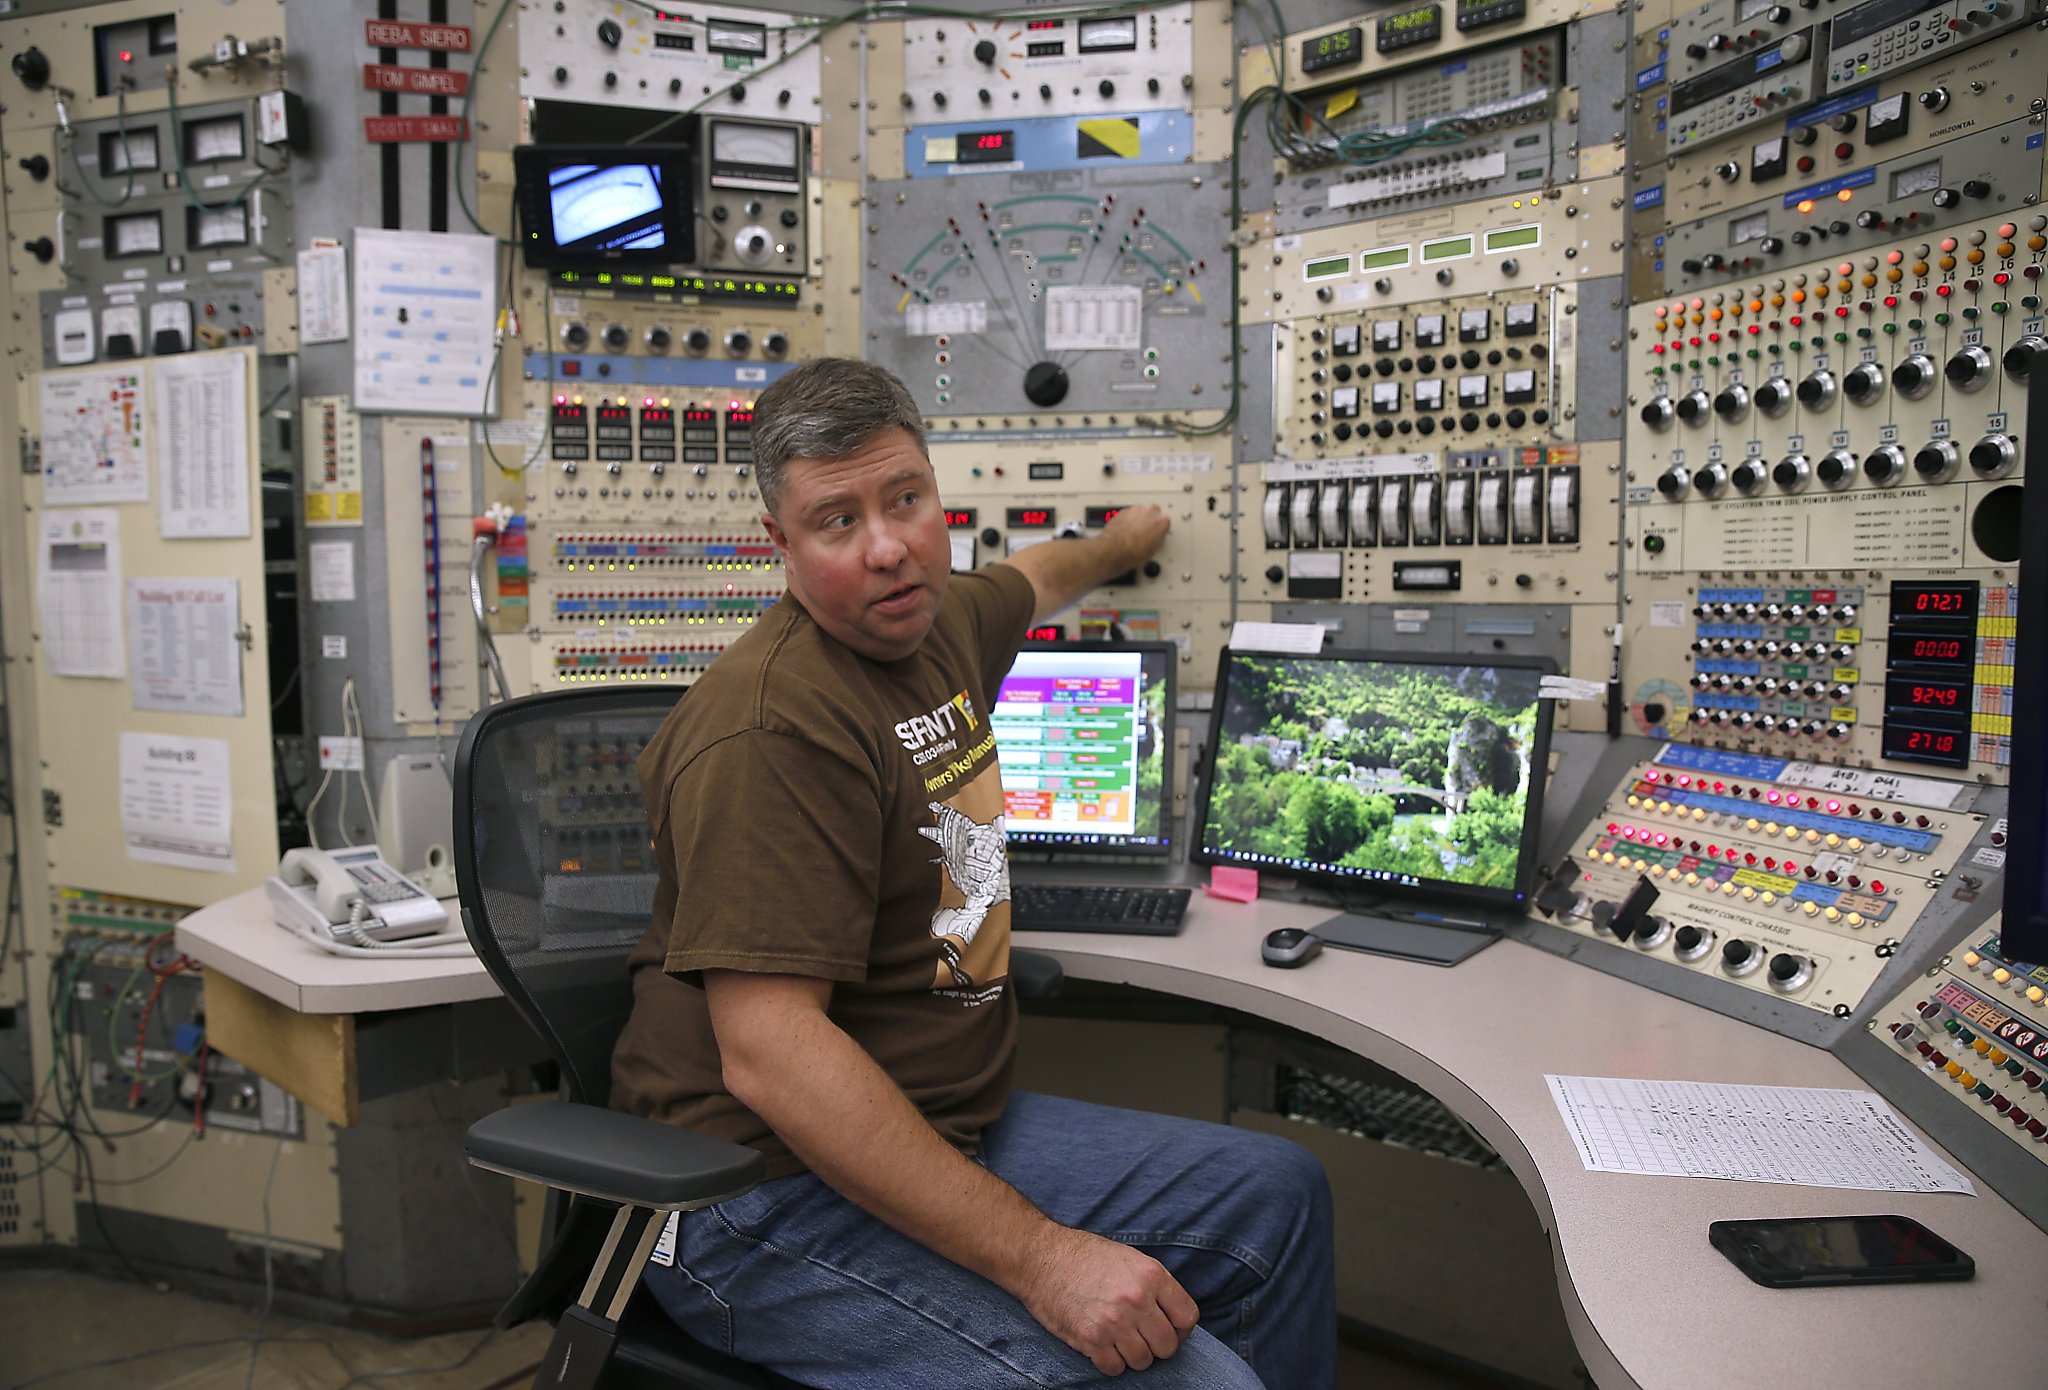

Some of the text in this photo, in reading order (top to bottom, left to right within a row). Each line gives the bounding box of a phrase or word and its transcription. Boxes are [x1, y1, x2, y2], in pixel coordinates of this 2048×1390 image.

[368, 24, 467, 48] REBA SIERO
[373, 68, 405, 87] TOM
[1929, 119, 1976, 139] HORIZONTAL
[2031, 251, 2046, 264] 17
[1999, 259, 2014, 271] 16
[1970, 266, 1984, 277] 15
[1916, 278, 1928, 288] 13
[1942, 272, 1956, 283] 14
[1865, 290, 1876, 299] 11
[1889, 284, 1902, 294] 12
[1840, 295, 1851, 305] 10
[2027, 323, 2039, 332] 17
[1967, 334, 1977, 342] 16
[1989, 418, 2001, 427] 15
[1883, 430, 1893, 438] 12
[1934, 424, 1945, 433] 14
[1861, 491, 1897, 501] CONTROL
[1901, 490, 1927, 498] PANEL
[148, 746, 182, 763] Building
[1687, 903, 1719, 916] MAGNET
[1718, 911, 1755, 926] CONTROL
